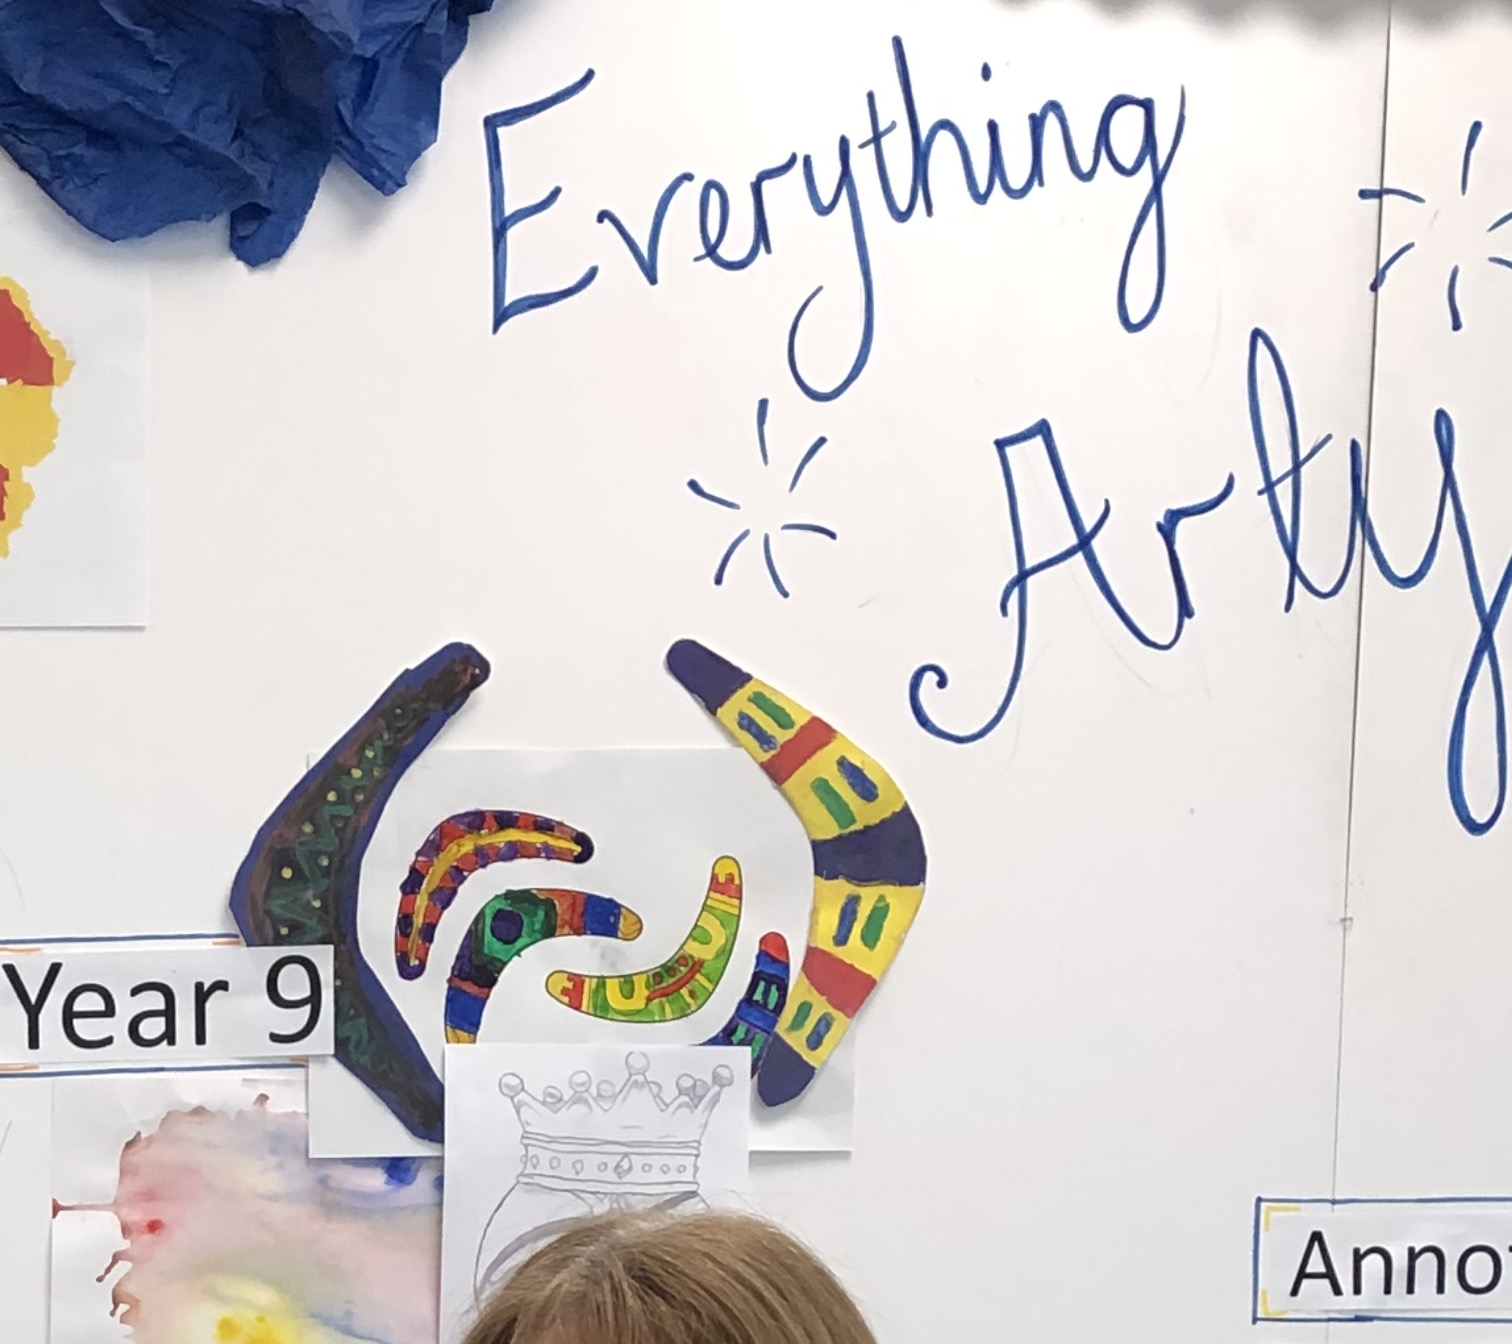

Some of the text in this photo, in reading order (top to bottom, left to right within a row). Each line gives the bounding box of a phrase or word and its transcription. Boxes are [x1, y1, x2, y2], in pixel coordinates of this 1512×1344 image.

[483, 34, 1186, 401] Everything
[908, 327, 1512, 835] Arty
[2, 954, 323, 1051] Year 9
[1289, 1230, 1512, 1298] Anno
